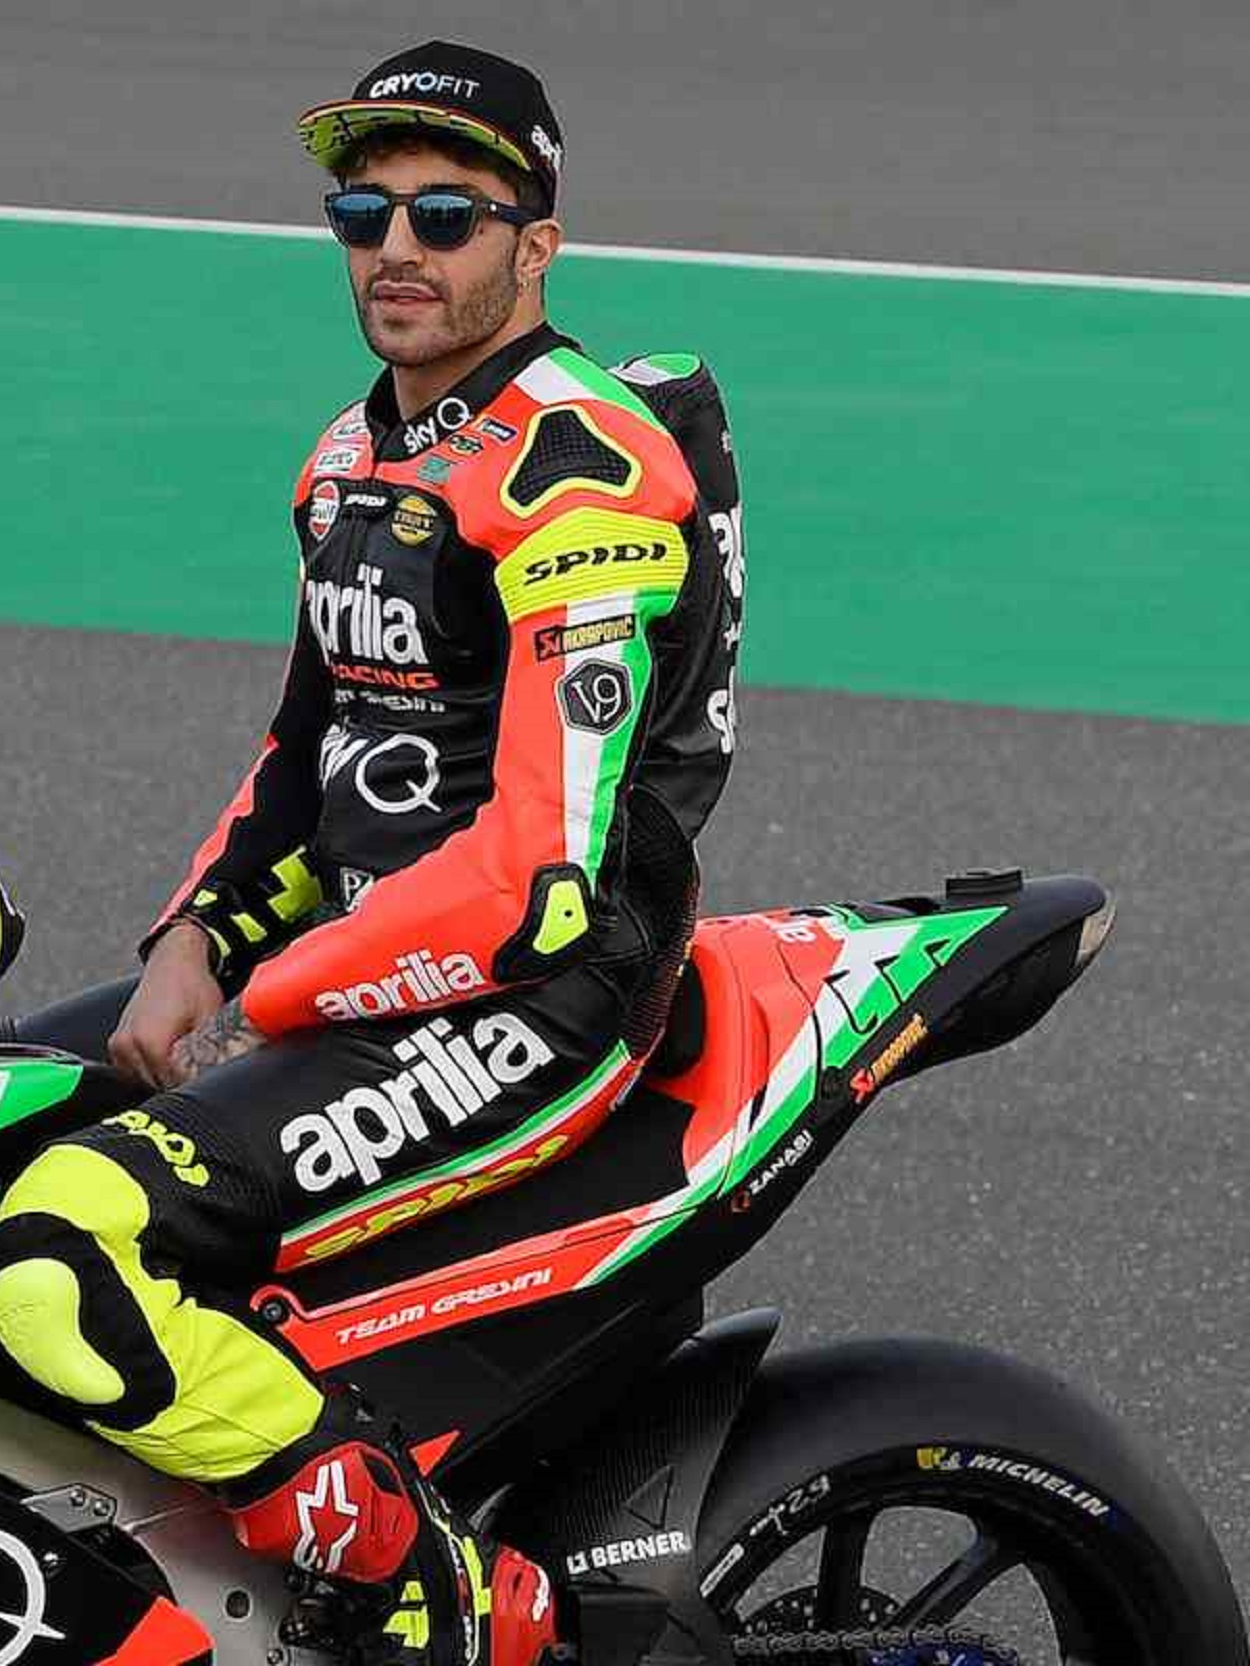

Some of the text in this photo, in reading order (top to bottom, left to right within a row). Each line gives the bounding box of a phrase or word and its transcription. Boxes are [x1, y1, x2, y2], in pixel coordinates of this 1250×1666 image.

[369, 71, 481, 99] CRYOFIT
[404, 418, 437, 454] sky
[437, 397, 473, 430] Q
[523, 543, 667, 586] SPIDI
[306, 563, 430, 667] prilia
[315, 950, 484, 1020] aprilia
[280, 1009, 553, 1193] aprilia
[749, 1128, 814, 1196] ZANASI
[967, 1453, 1111, 1518] MICHELIN
[591, 1531, 692, 1569] BERNER
